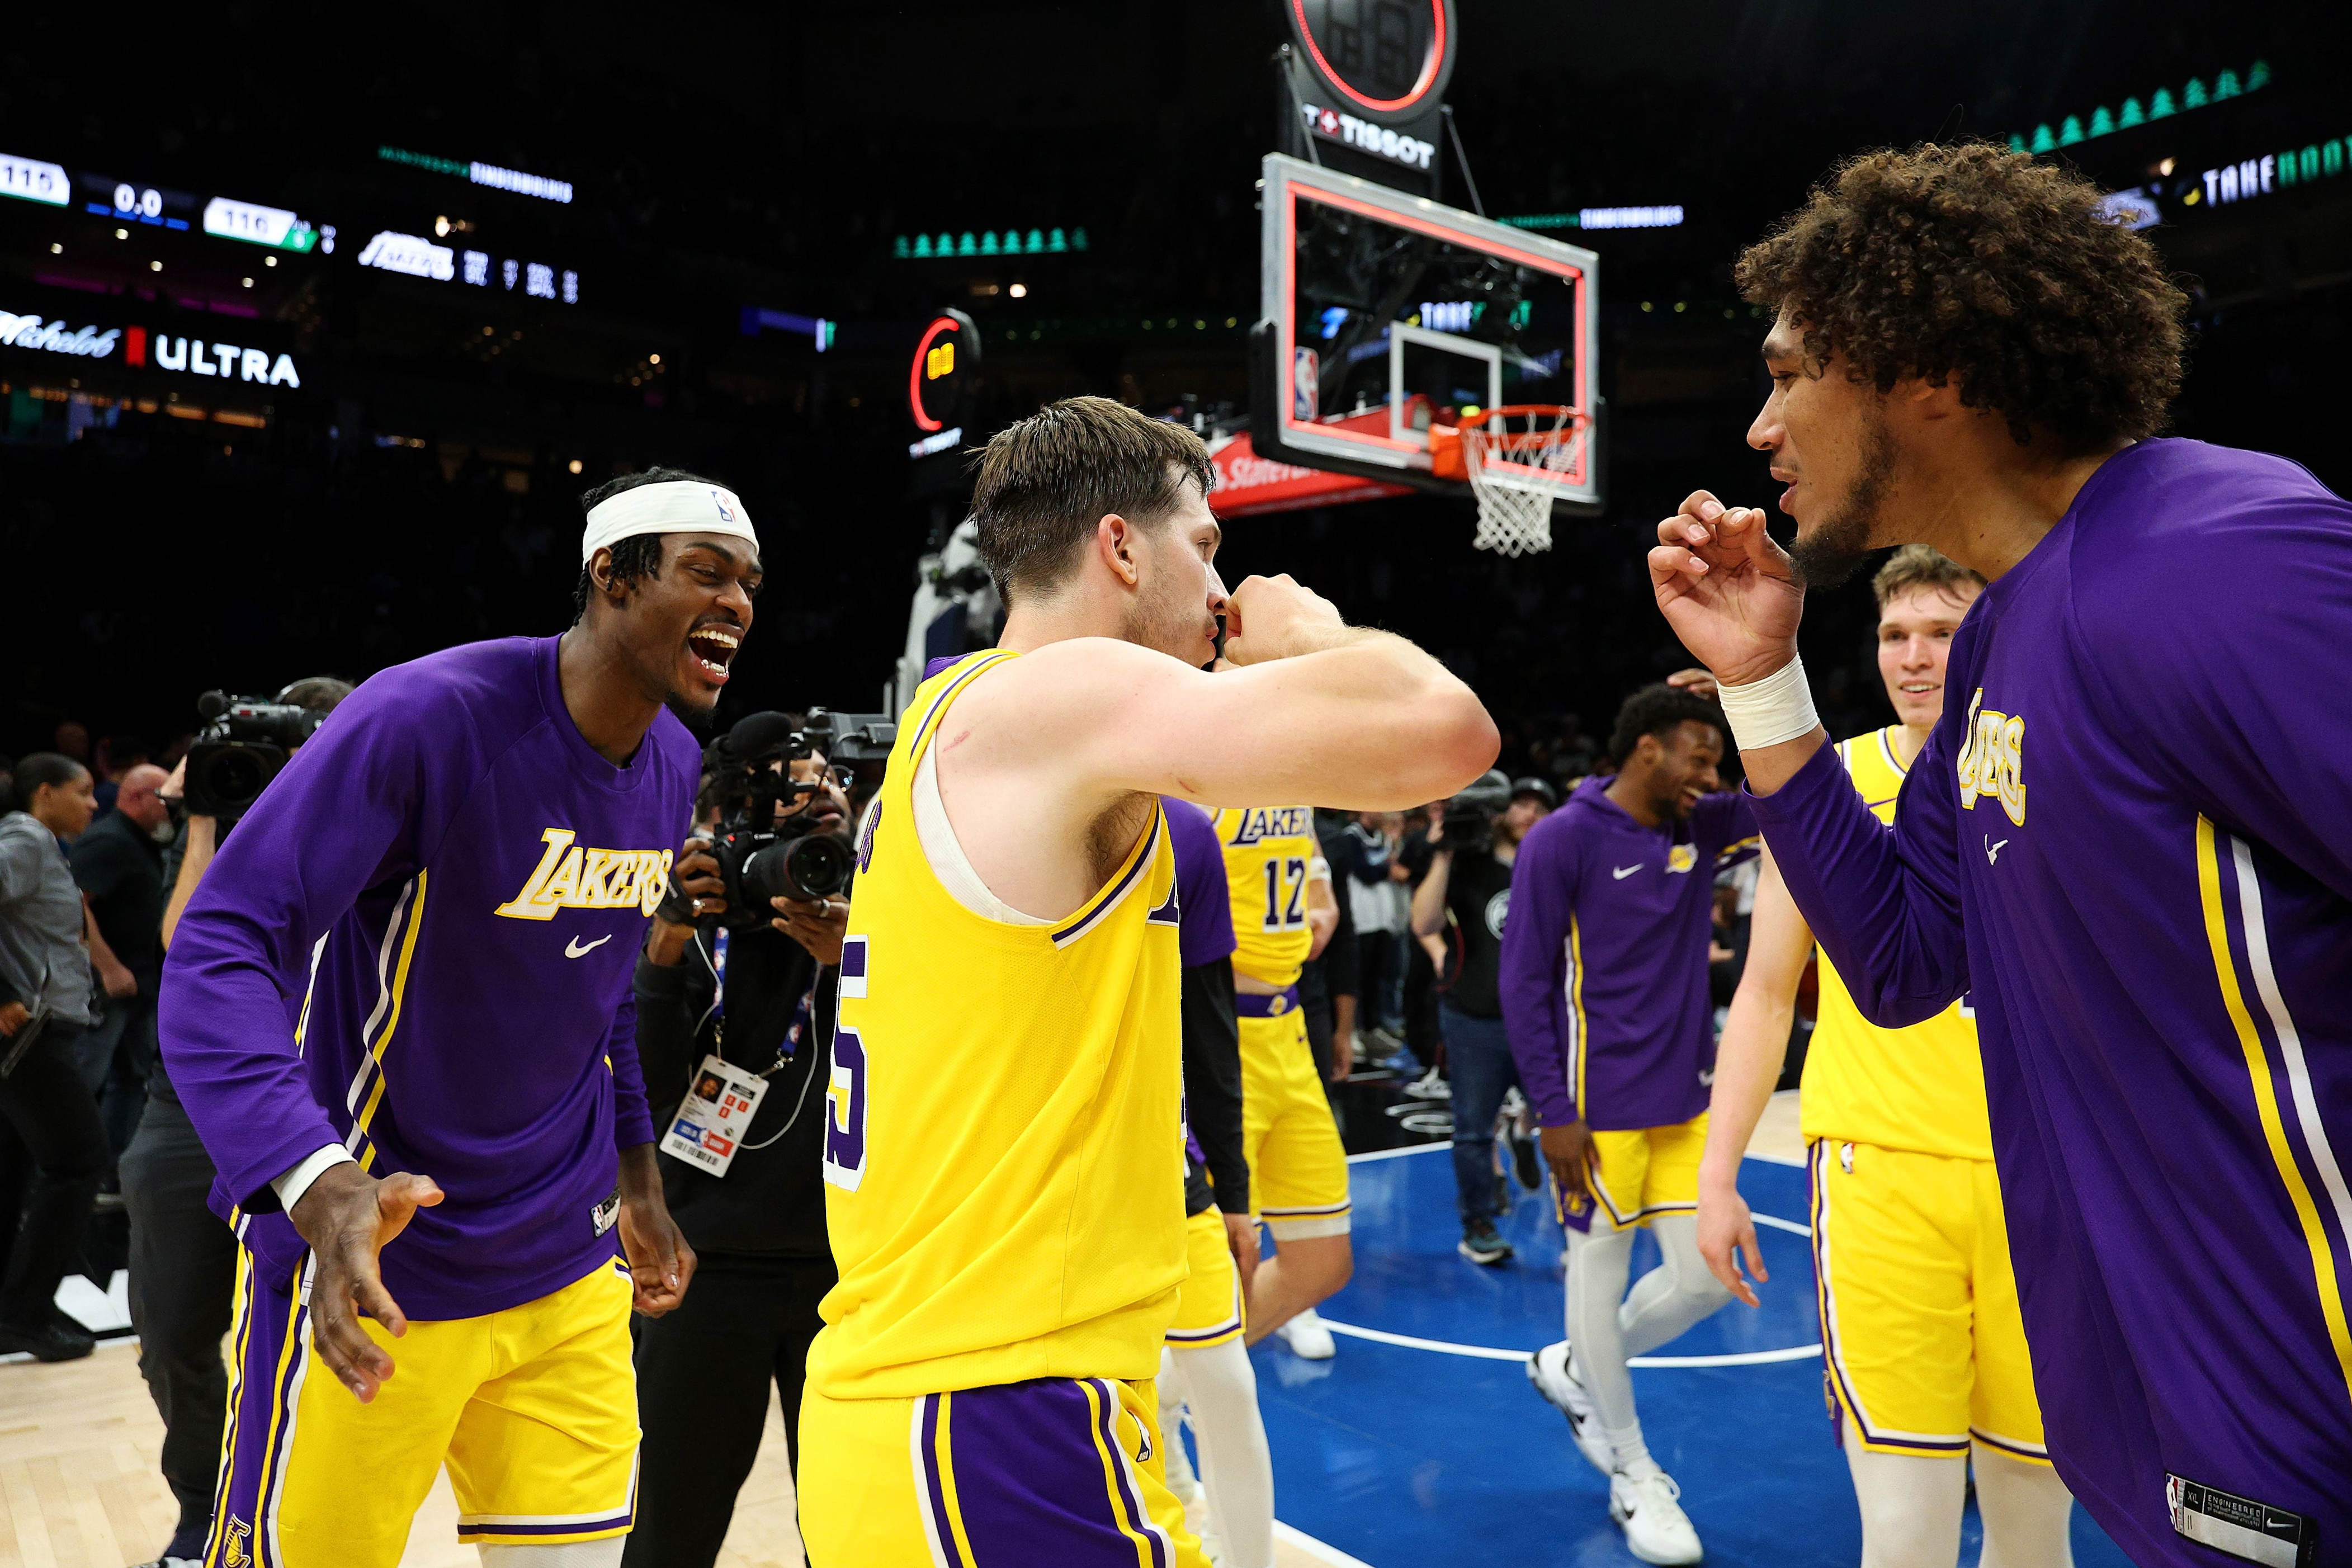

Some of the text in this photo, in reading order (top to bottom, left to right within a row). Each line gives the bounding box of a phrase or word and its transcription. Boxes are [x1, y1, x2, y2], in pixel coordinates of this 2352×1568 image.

[1339, 114, 1435, 169] TISSOT
[113, 183, 163, 218] 0.0
[155, 334, 301, 389] ULTRA
[494, 828, 674, 921] LAKERS
[1262, 856, 1306, 933] 12
[2208, 1494, 2261, 1518] ENGINEERED
